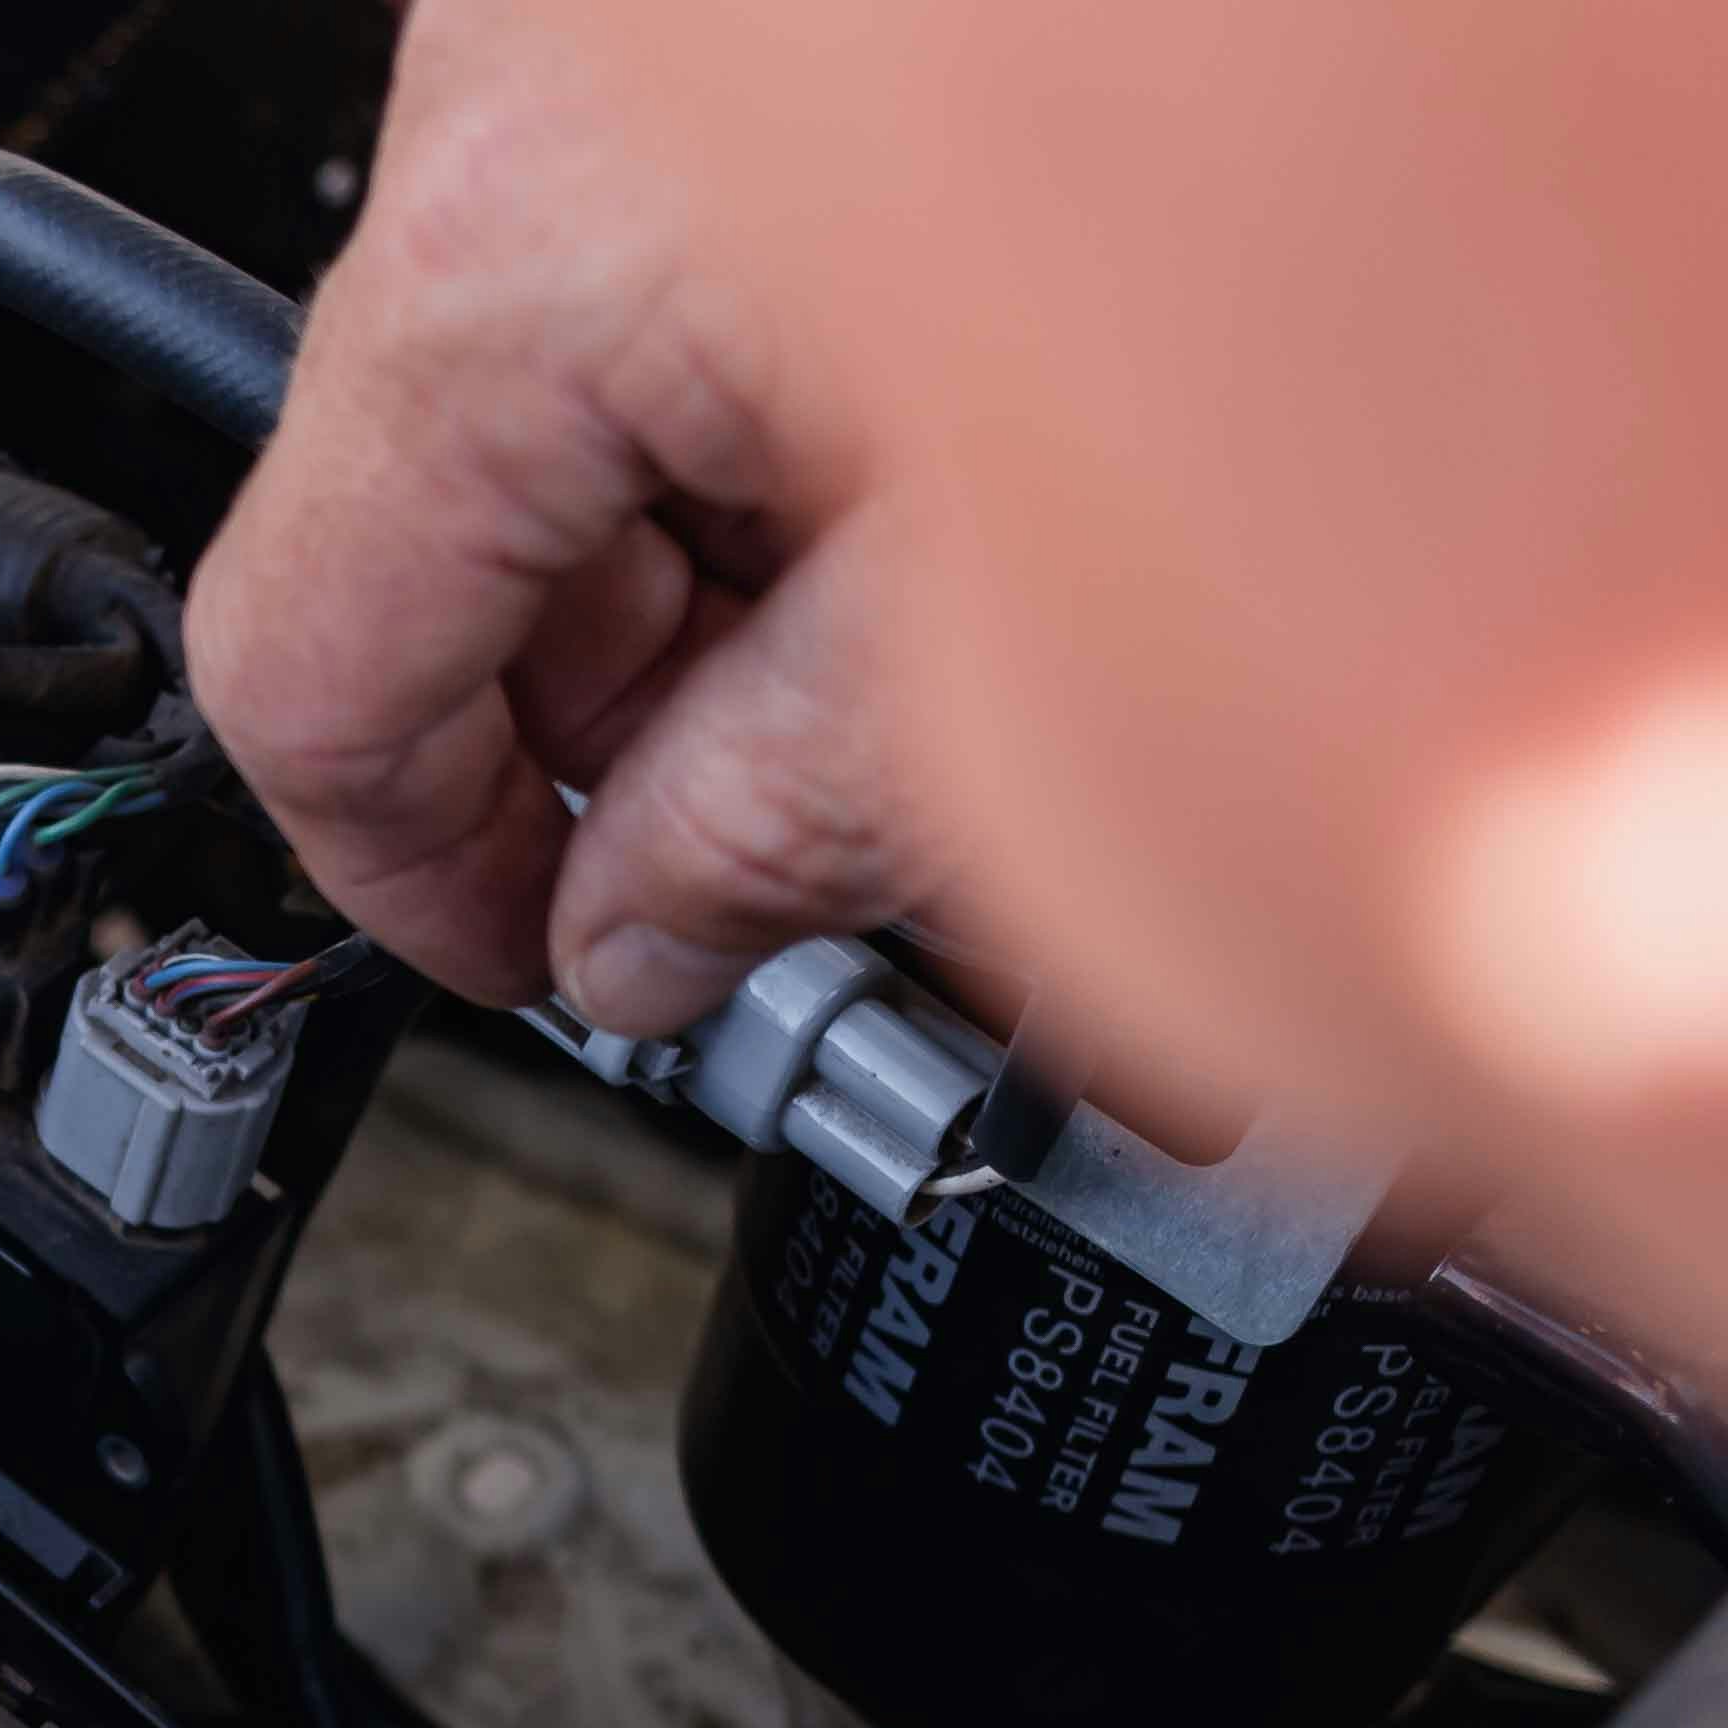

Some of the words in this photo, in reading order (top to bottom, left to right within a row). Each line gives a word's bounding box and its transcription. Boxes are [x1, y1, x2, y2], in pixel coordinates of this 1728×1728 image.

[843, 1195, 978, 1428] FRAM
[961, 1262, 1106, 1493] PS8404
[1089, 1299, 1161, 1387] FUEL
[1039, 1396, 1118, 1515] FILTER
[1099, 1313, 1265, 1548] FRAM
[1266, 1343, 1416, 1557] PS8404
